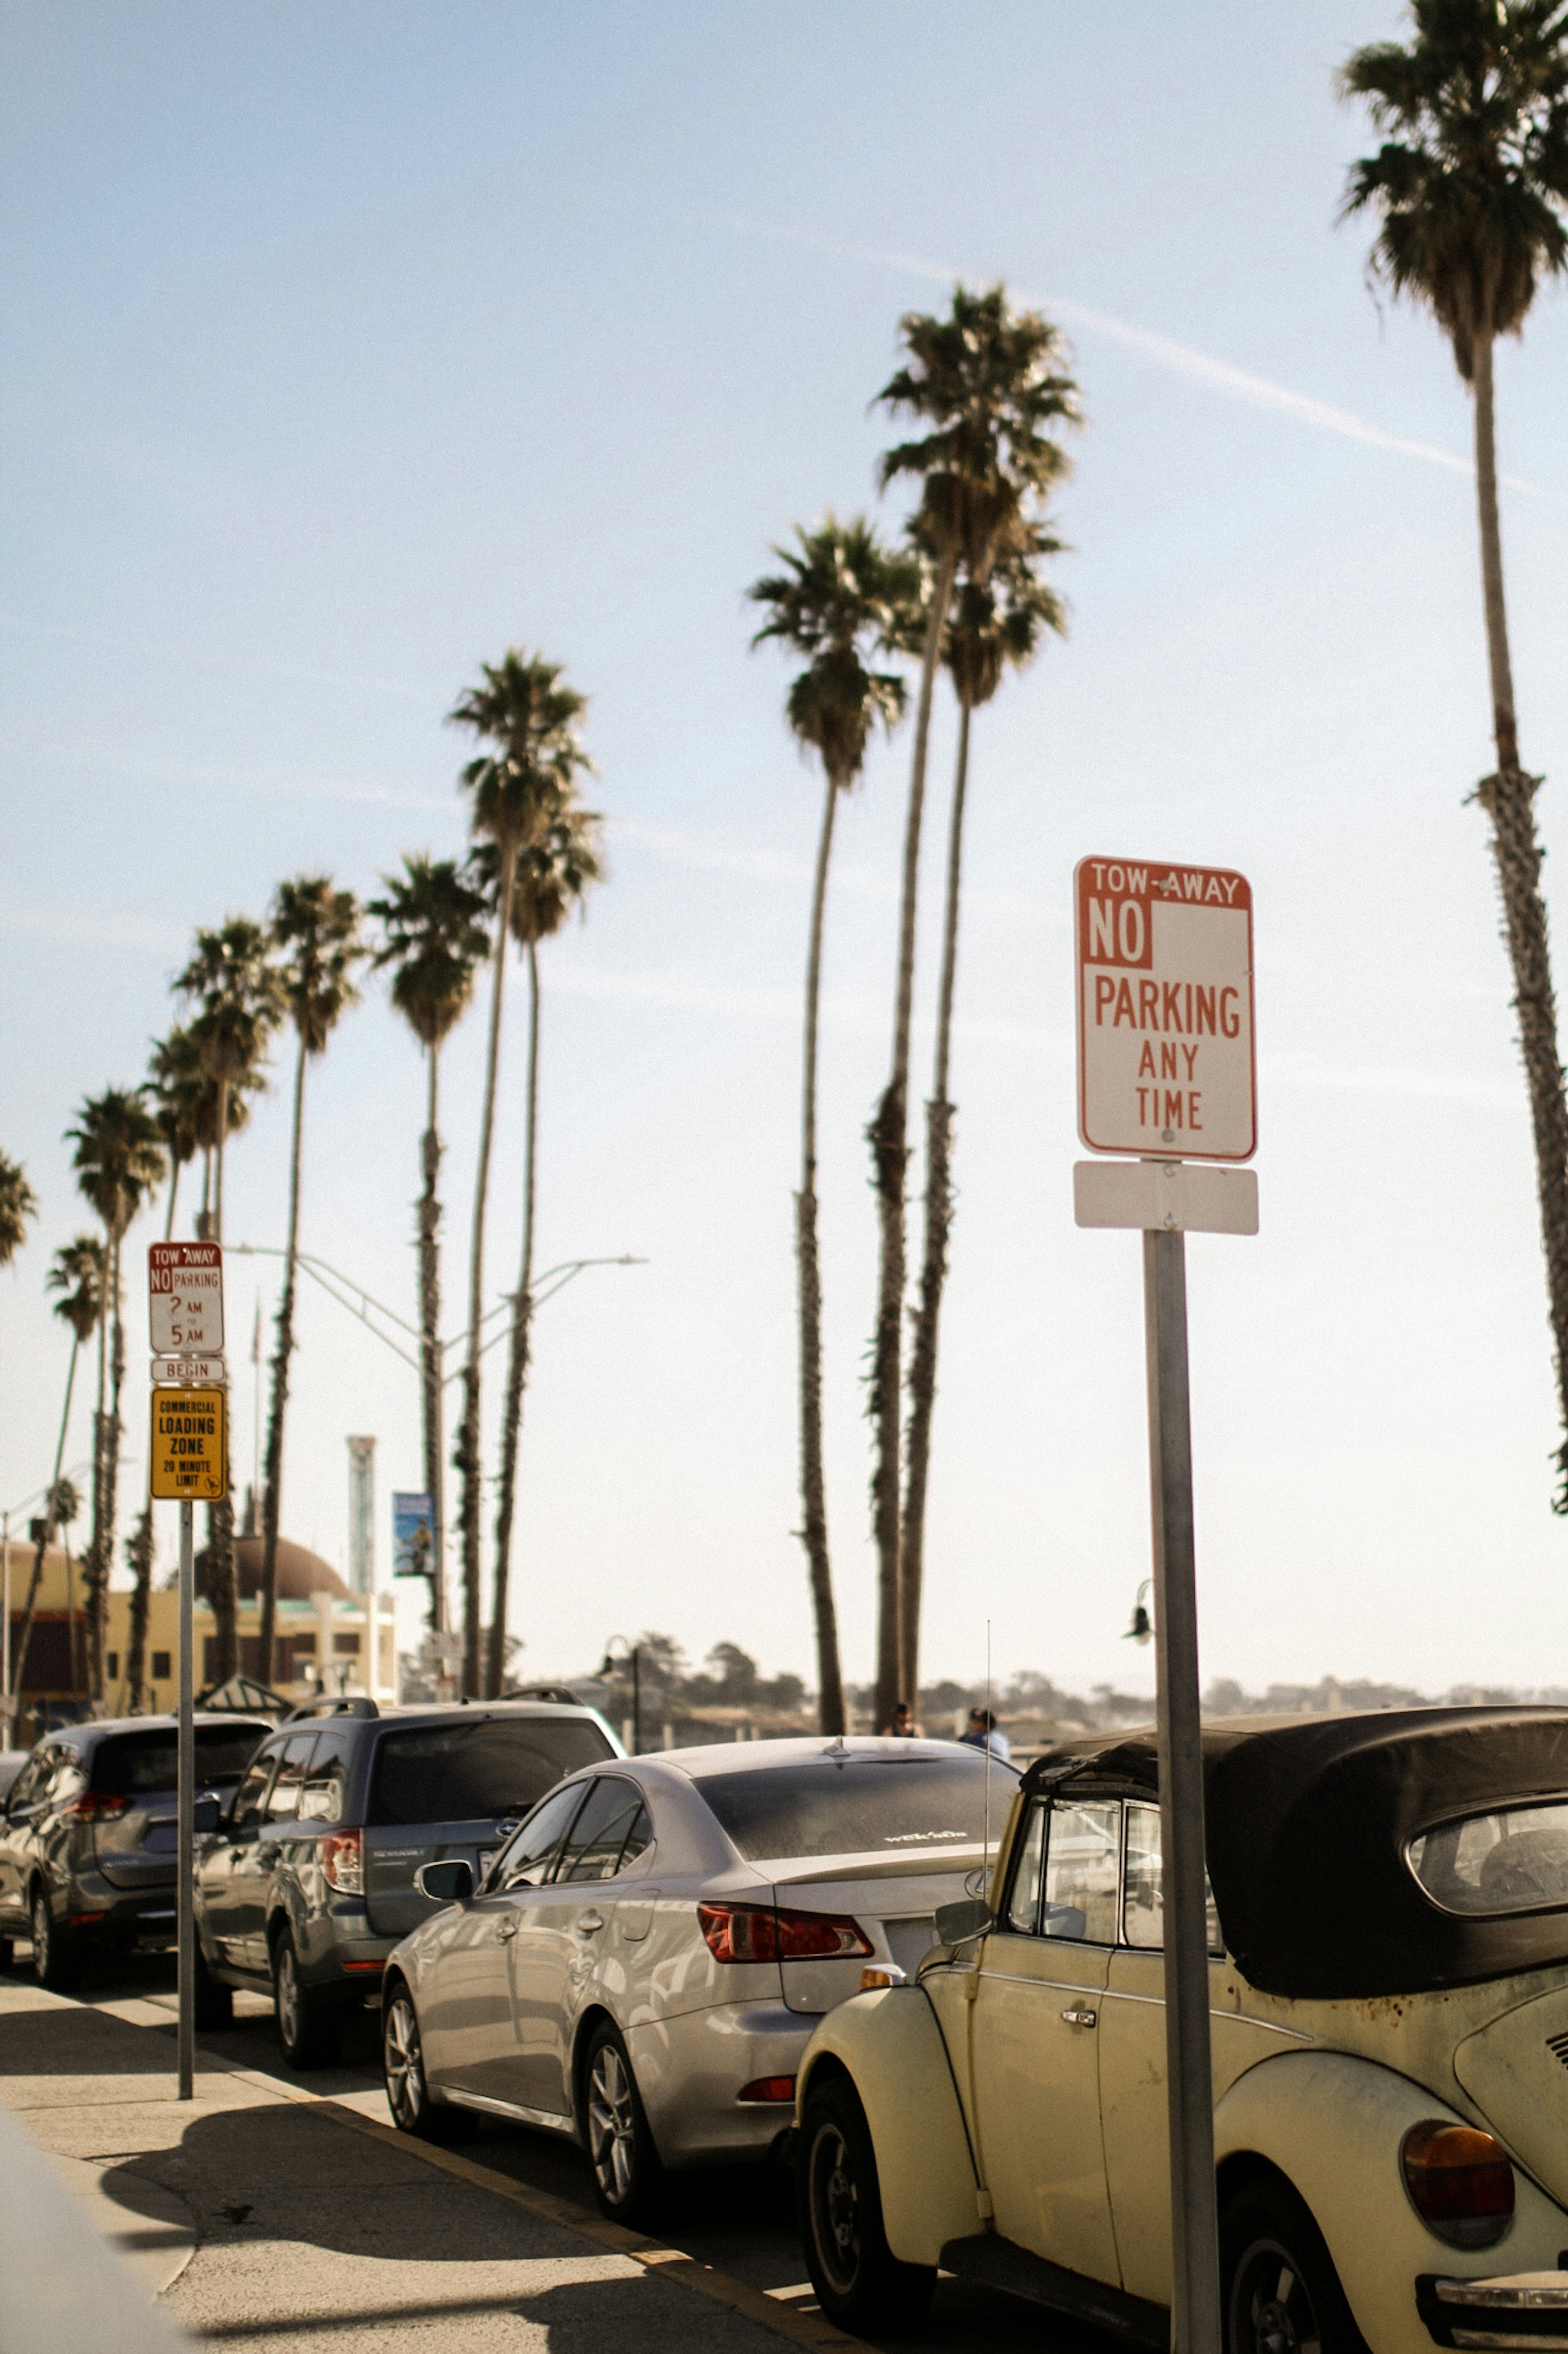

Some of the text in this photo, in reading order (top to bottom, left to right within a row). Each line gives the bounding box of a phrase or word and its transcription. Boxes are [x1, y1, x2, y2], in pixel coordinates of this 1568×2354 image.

[1091, 863, 1239, 904] TOW-AWAY
[1089, 897, 1144, 962] NO
[1095, 975, 1239, 1038] PARKING
[1139, 1040, 1198, 1081] ANY
[1136, 1088, 1202, 1130] TIME
[154, 1249, 215, 1266] TOW AWAY
[151, 1268, 218, 1291] NO PARKING
[187, 1301, 202, 1314] AM
[171, 1324, 203, 1346] 5 AM
[167, 1363, 208, 1377] BEGIN
[160, 1401, 215, 1413] COMMERCIAL
[159, 1417, 215, 1434] LOADING
[170, 1438, 204, 1455] ZONE
[164, 1460, 211, 1473] 20 MINUTE
[176, 1474, 199, 1486] LIMIT
